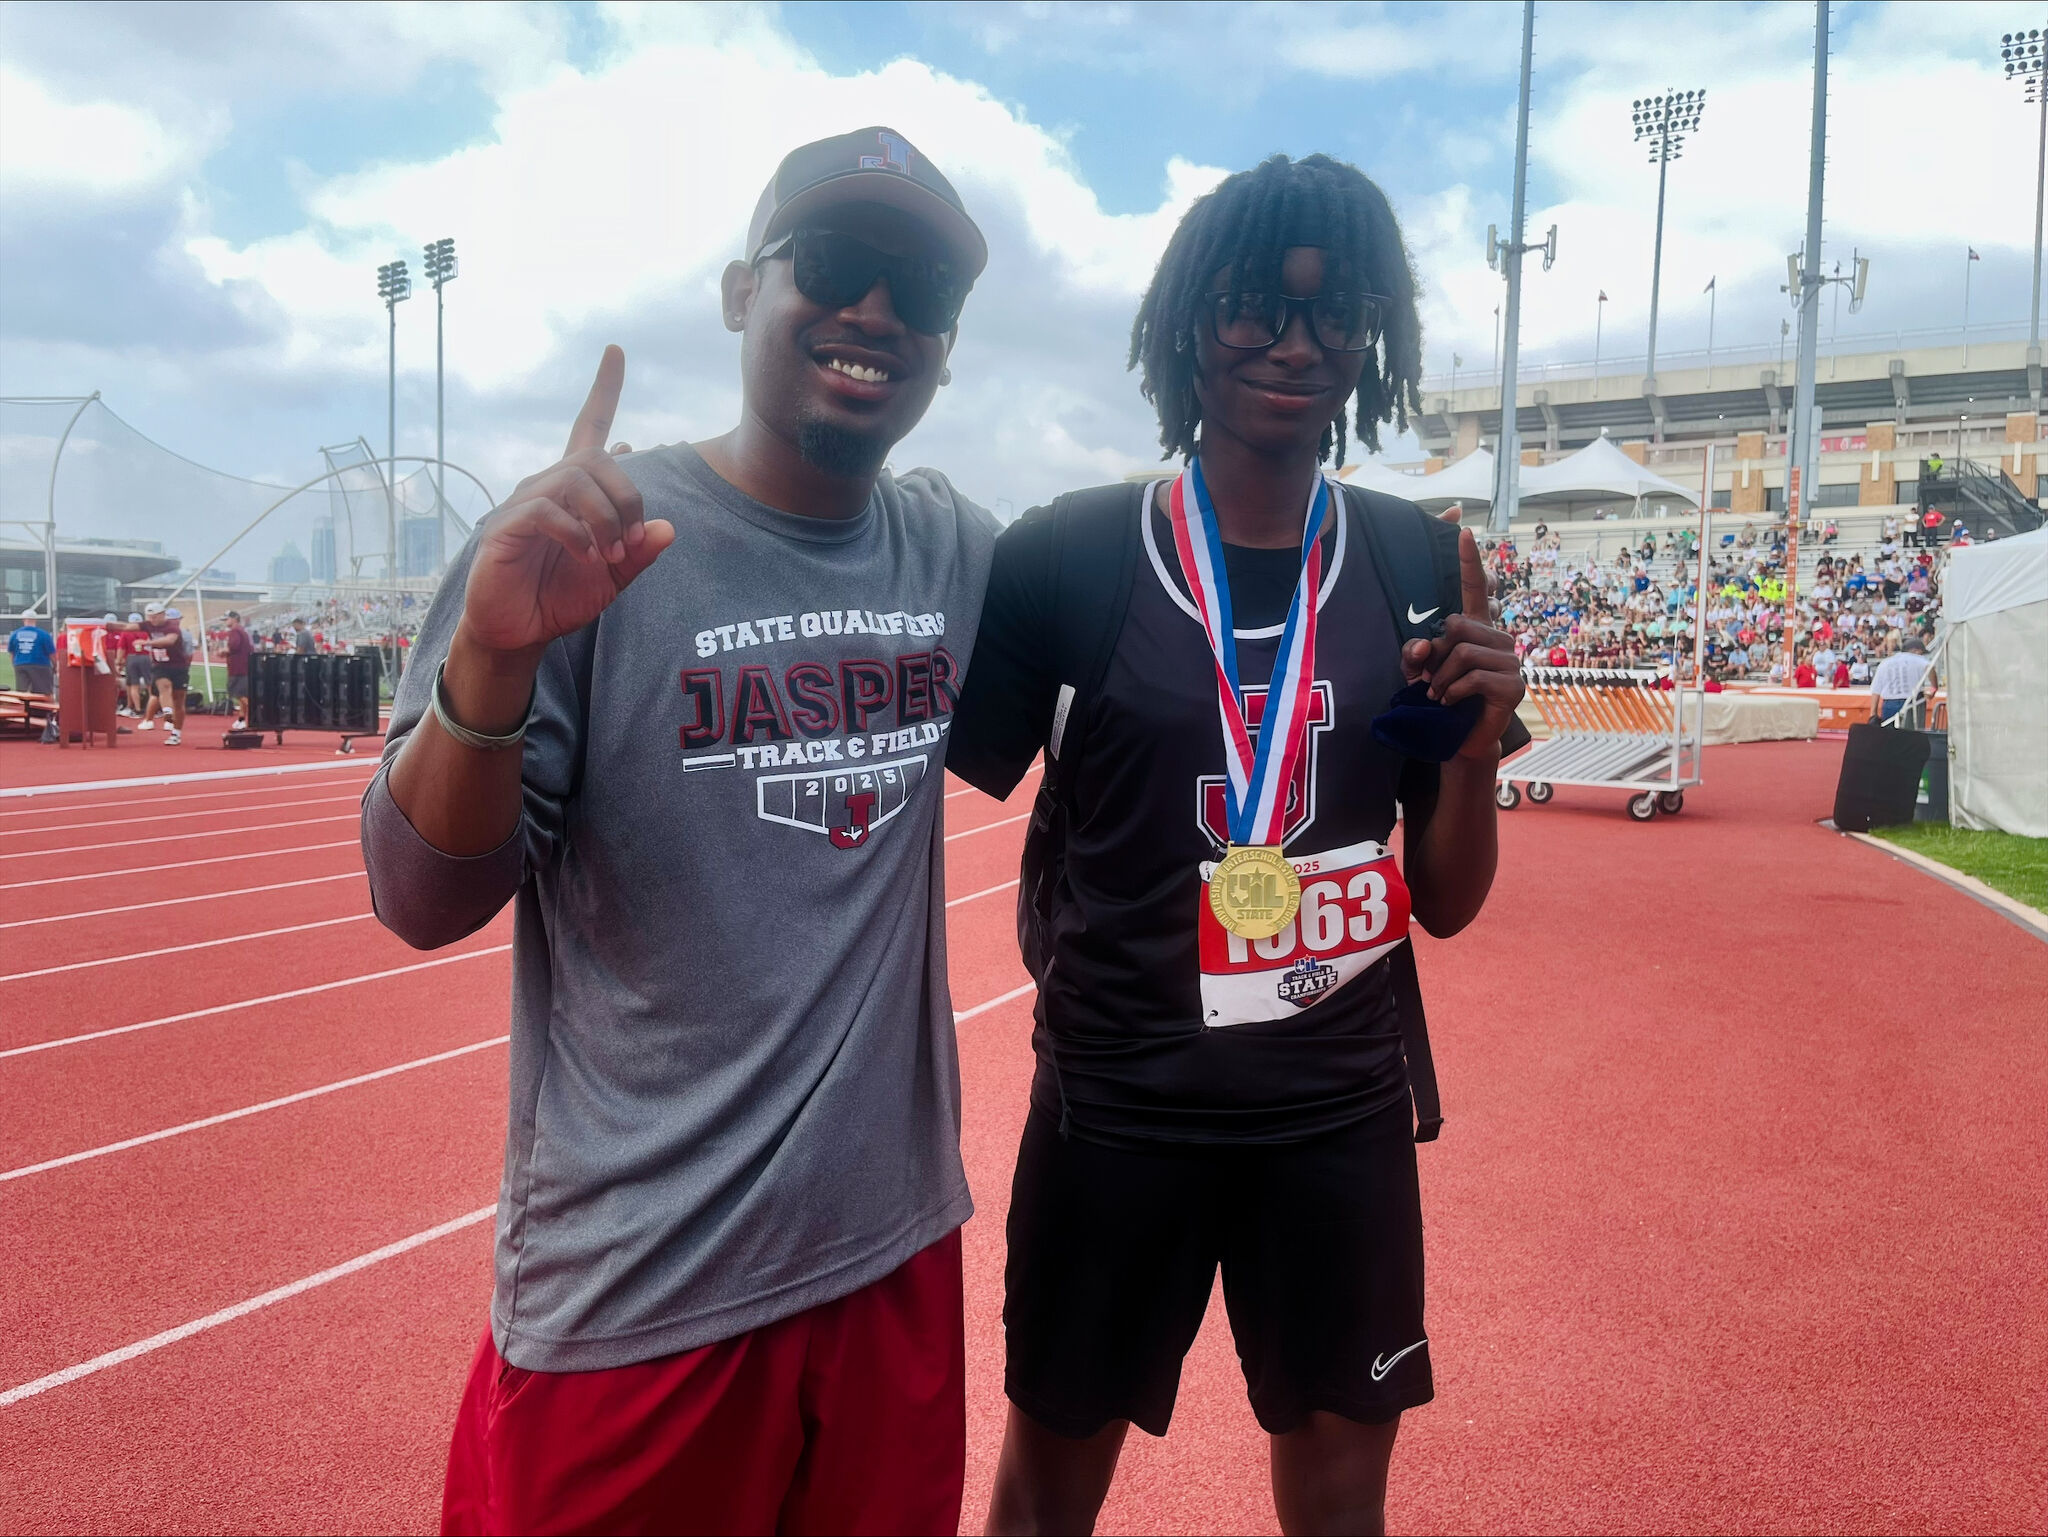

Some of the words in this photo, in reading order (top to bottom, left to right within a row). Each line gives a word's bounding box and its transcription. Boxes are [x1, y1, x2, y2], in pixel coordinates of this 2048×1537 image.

[695, 615, 796, 658] STATE
[679, 646, 961, 749] JASPER
[737, 739, 844, 769] TRACK
[871, 722, 940, 755] FIELD
[806, 769, 897, 796] 2025
[1222, 850, 1298, 886] INTERSCHOLASTIC
[1293, 861, 1320, 875] 025
[1236, 908, 1273, 920] STATE
[1279, 972, 1338, 997] STATE
